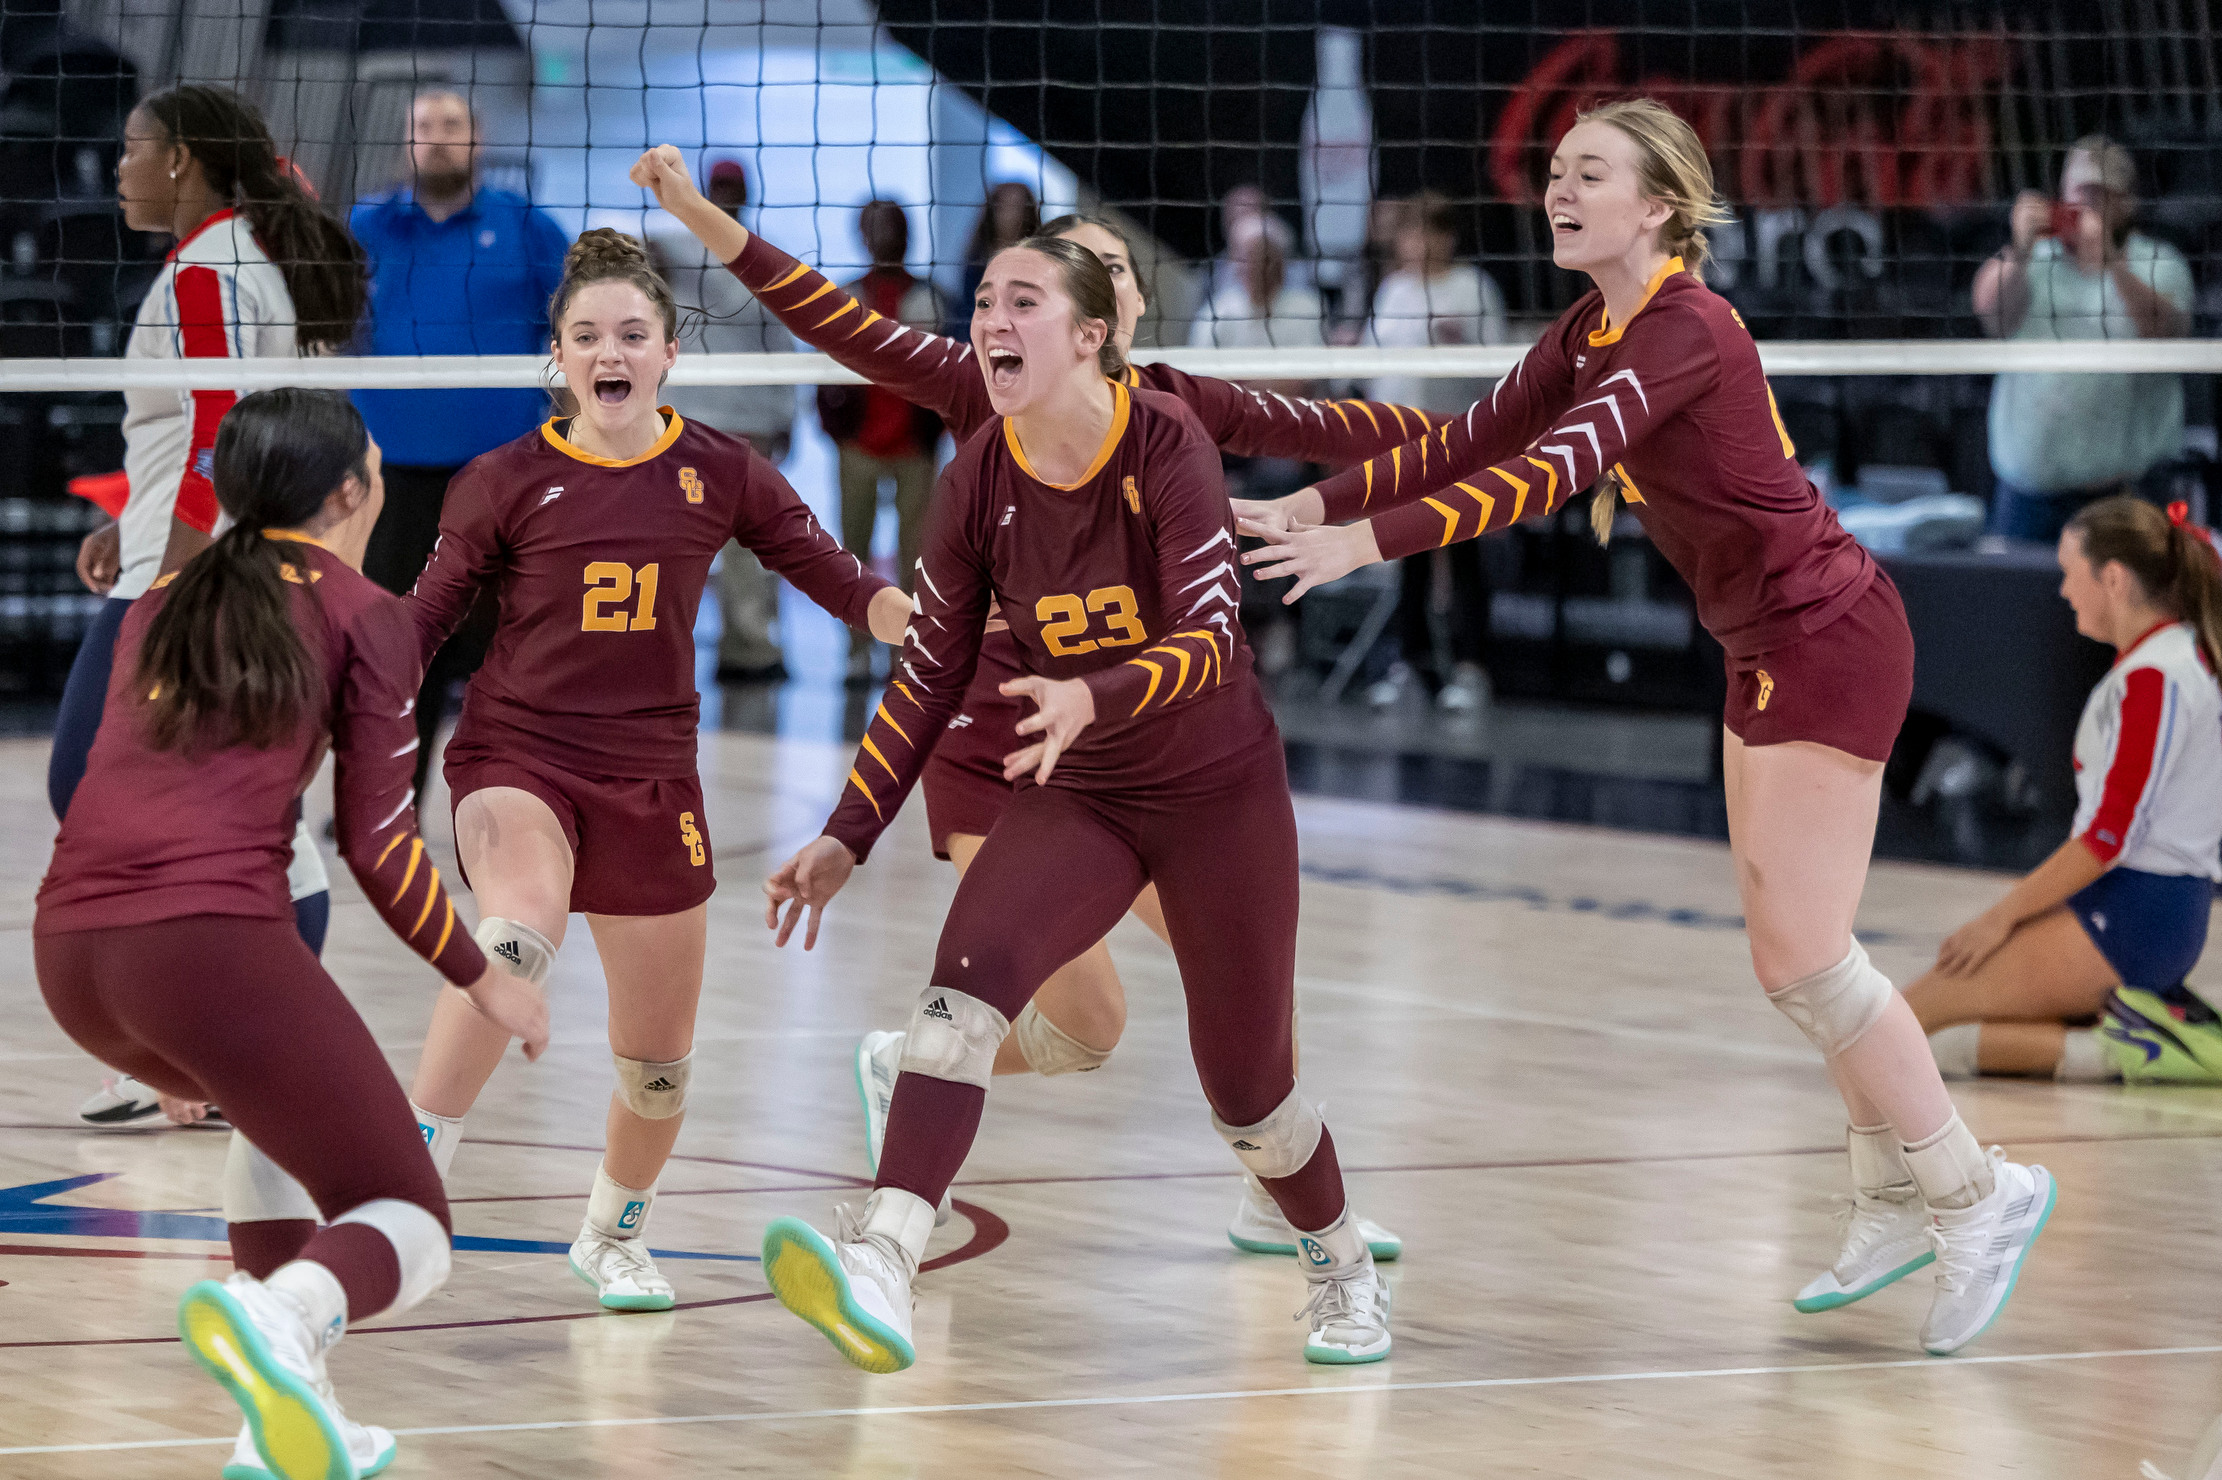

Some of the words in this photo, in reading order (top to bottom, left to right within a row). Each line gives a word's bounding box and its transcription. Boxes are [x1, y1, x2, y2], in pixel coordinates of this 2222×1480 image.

[581, 561, 659, 632] 21
[1036, 585, 1148, 657] 23
[494, 945, 521, 965] adidas
[923, 1008, 953, 1021] adidas
